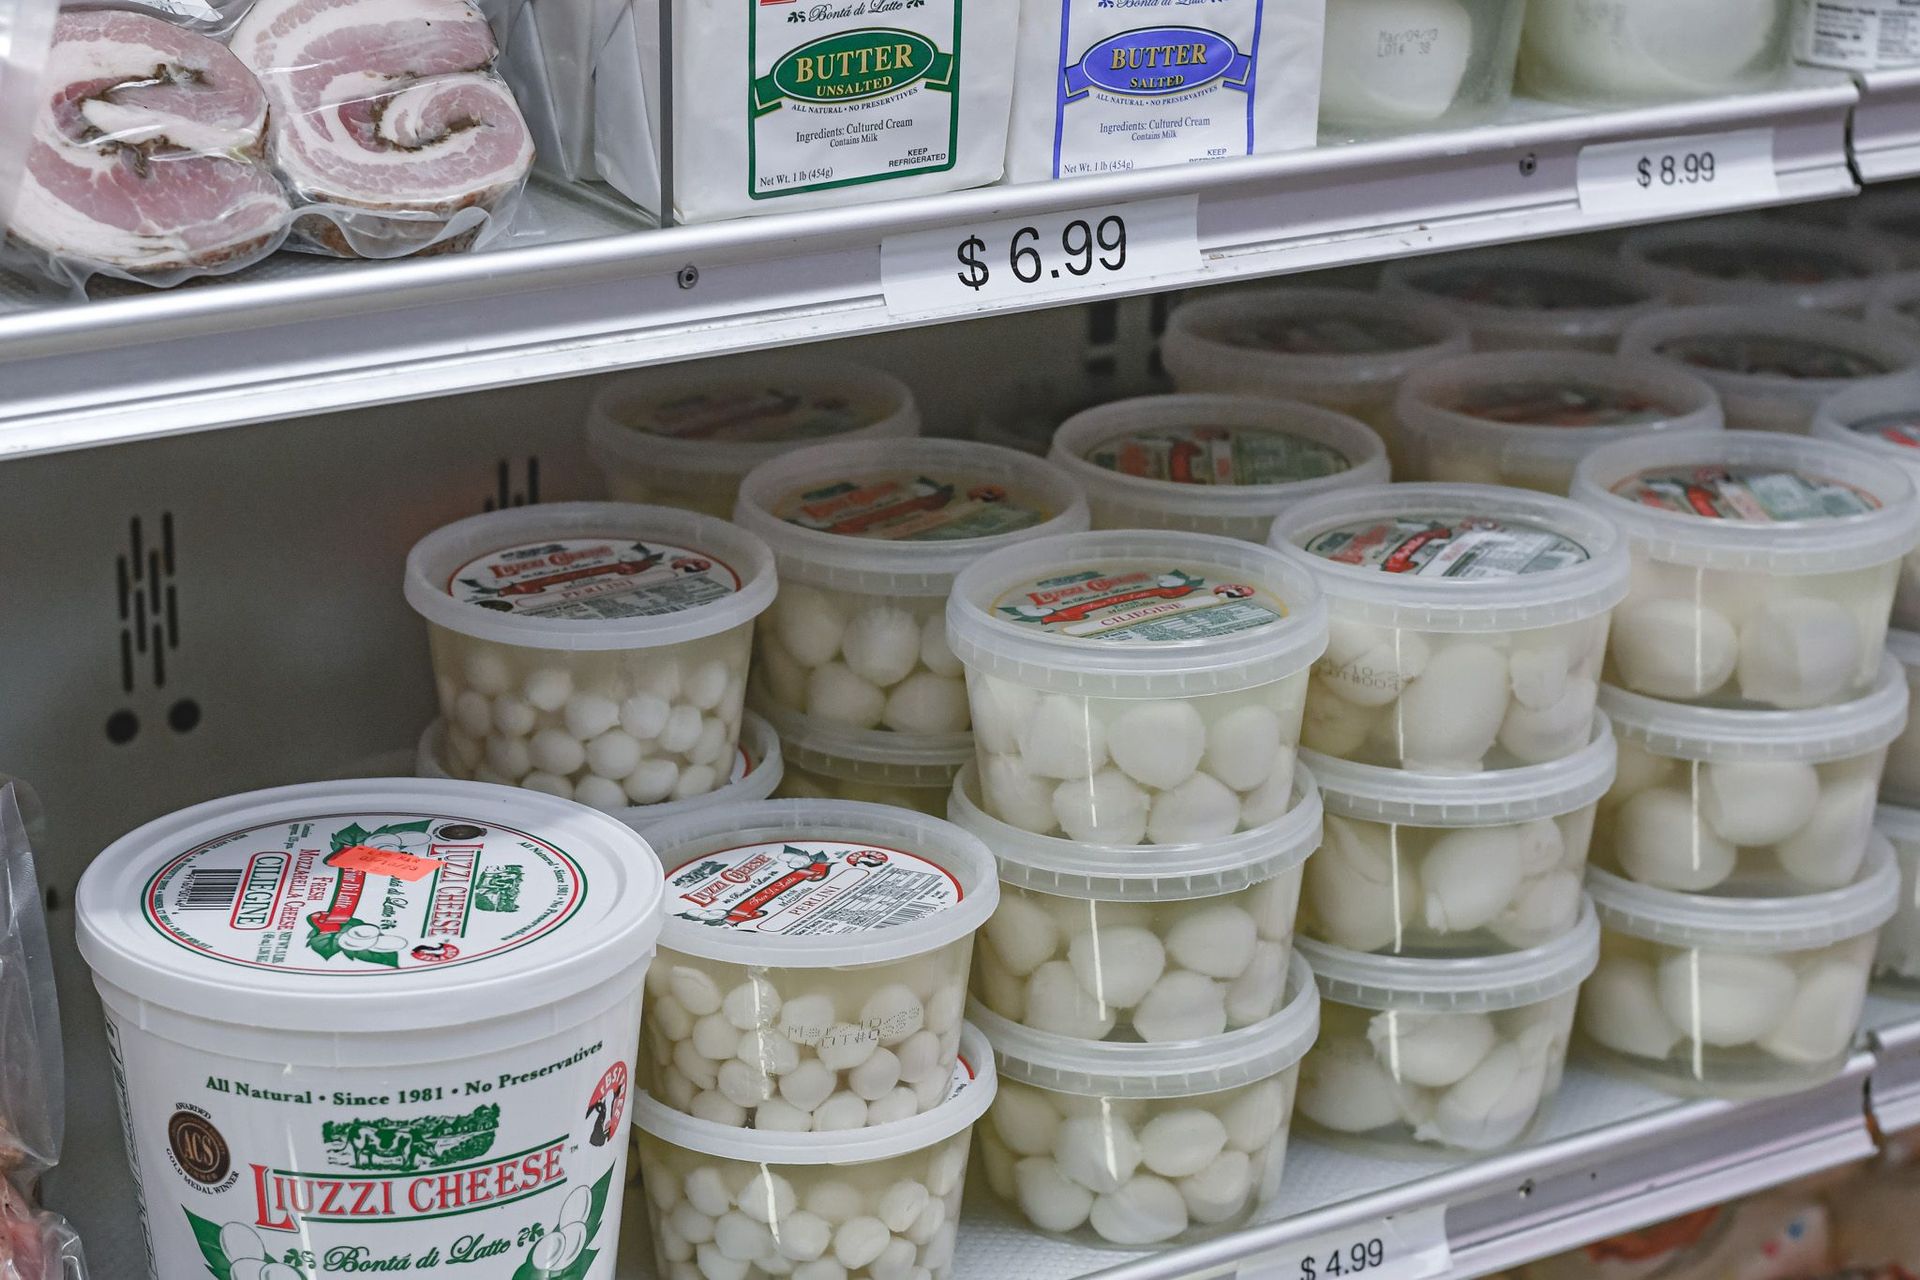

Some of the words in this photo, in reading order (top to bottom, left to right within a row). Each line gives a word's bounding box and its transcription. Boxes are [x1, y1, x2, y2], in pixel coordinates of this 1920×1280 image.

[854, 2, 865, 16] di
[868, 0, 903, 13] Latte
[796, 43, 914, 83] BUTTER
[1110, 43, 1207, 70] BUTTER
[816, 75, 893, 96] UNSALTED
[1130, 75, 1185, 88] SALTED
[1096, 93, 1109, 102] ALL
[1110, 97, 1144, 106] NATURAL
[1150, 98, 1161, 106] NO
[1162, 85, 1218, 105] PRESERVATIVES
[791, 104, 807, 112] ALL
[808, 106, 844, 114] NATURAL
[848, 104, 860, 112] NO
[796, 127, 845, 144] Ingredients:
[846, 120, 884, 135] Cultured
[886, 118, 913, 130] Cream
[1099, 121, 1147, 135] Ingredients:
[1149, 118, 1183, 130] Cultured
[1185, 117, 1211, 127] Cream
[1131, 131, 1160, 142] Contains
[1161, 130, 1177, 139] Milk
[830, 135, 860, 148] Contains
[861, 133, 878, 143] Milk
[907, 147, 928, 157] KEEP
[1207, 148, 1227, 156] KEEP
[888, 153, 946, 168] REFRIGERATED
[1064, 164, 1077, 174] Net
[1079, 162, 1092, 172] Wt.
[1100, 161, 1108, 171] lb
[1109, 159, 1134, 171] (454g)
[1637, 156, 1652, 189] $
[1660, 151, 1715, 186] 8.99
[760, 176, 774, 187] Net
[776, 174, 790, 185] Wt.
[799, 170, 807, 181] lb
[808, 166, 834, 180] (454g)
[957, 233, 990, 291] $
[1010, 215, 1127, 283] 6.99
[1100, 601, 1182, 626] CILIEGINE
[518, 841, 533, 849] All
[287, 848, 321, 899] MOZZARELLA
[429, 843, 485, 883] LIUZZI
[553, 868, 565, 883] Since
[236, 856, 284, 925] CILIEGINE
[307, 876, 333, 901] FRESH
[339, 883, 360, 892] Di
[557, 884, 569, 898] 1981
[679, 880, 731, 908] LIUZZI
[428, 886, 468, 937] CHEESE
[788, 885, 841, 916] PERLINI
[277, 900, 306, 930] CHEESE
[206, 1076, 230, 1093] All
[235, 1081, 313, 1104] Natural
[333, 1091, 390, 1106] Since
[398, 1087, 443, 1104] 1981
[464, 1080, 492, 1096] No
[498, 1040, 603, 1089] Preservatives
[175, 1101, 212, 1120] AWARDED
[166, 1147, 183, 1176] GOLD
[183, 1174, 213, 1195] MEDAL
[213, 1170, 240, 1195] WINNER
[248, 1163, 396, 1232] LIUZZI
[408, 1143, 566, 1212] CHEESE
[416, 1247, 439, 1268] di
[446, 1234, 511, 1264] Latte
[1300, 1256, 1316, 1280] $
[1325, 1238, 1384, 1278] 4.99
